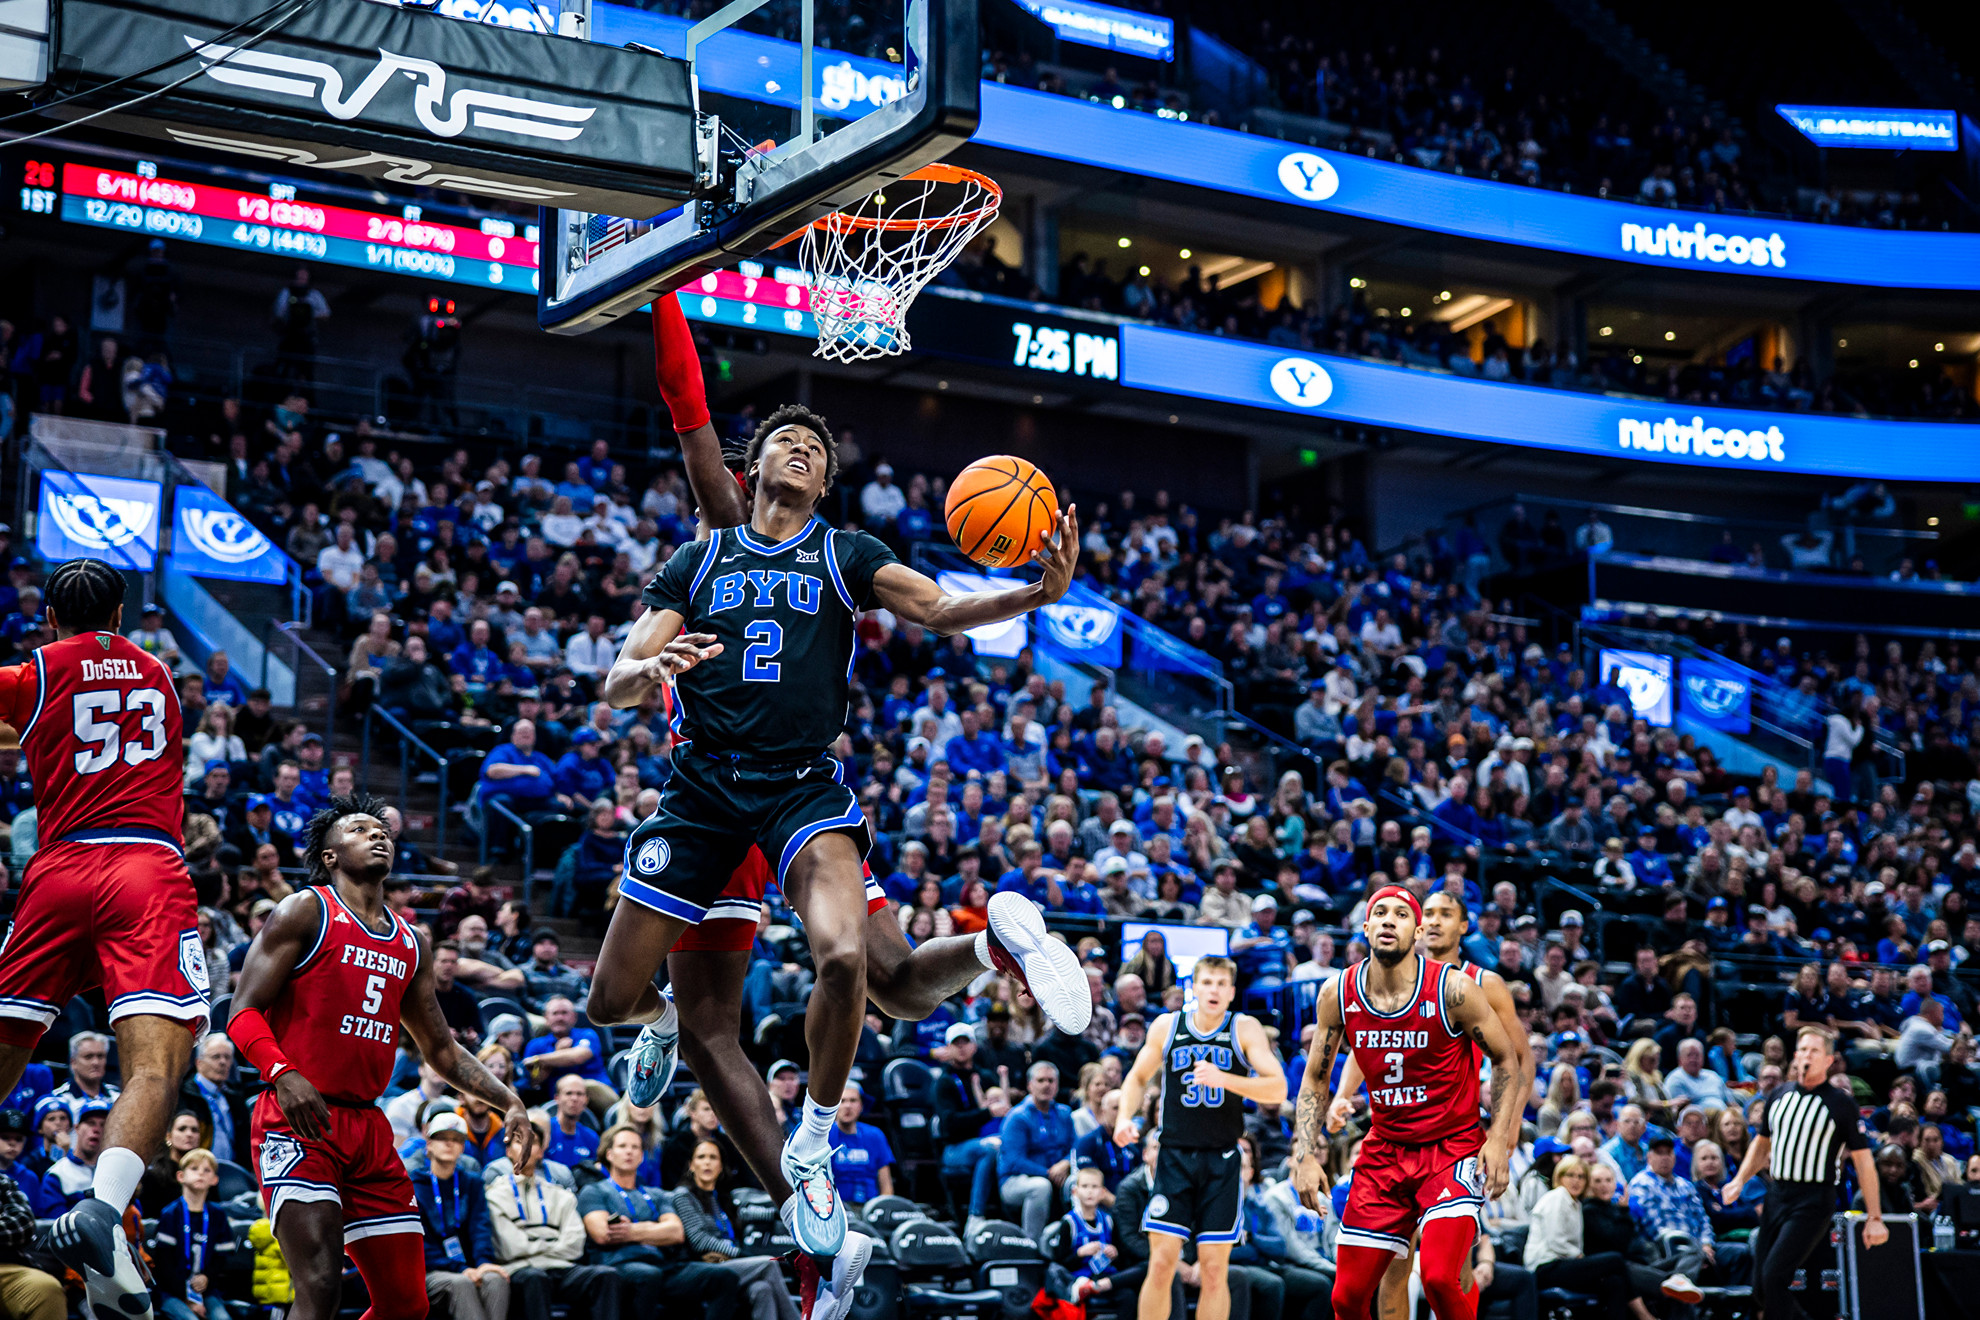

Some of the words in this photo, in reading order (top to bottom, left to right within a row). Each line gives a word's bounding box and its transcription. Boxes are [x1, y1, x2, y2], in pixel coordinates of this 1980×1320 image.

[24, 160, 55, 188] 26
[1294, 160, 1323, 192] Y
[20, 187, 57, 214] 1ST
[84, 198, 144, 229] 12/20
[145, 207, 203, 240] (60%)
[232, 222, 271, 248] 4/9
[272, 228, 328, 260] (44%)
[365, 242, 394, 268] 1/1
[394, 246, 456, 280] (100%)
[488, 262, 504, 285] 3
[742, 302, 758, 324] 2
[237, 196, 269, 221] 1/3
[270, 201, 326, 232] (33%)
[367, 216, 403, 243] 2/3
[487, 236, 505, 259] 0
[743, 277, 758, 299] 7
[1621, 222, 1786, 268] nutricost
[1012, 322, 1071, 373] 7:25
[1074, 332, 1118, 381] PM
[1287, 366, 1317, 398] Y
[1618, 416, 1785, 462] nutricost
[709, 569, 823, 615] BYU
[743, 619, 784, 682] 2
[81, 658, 143, 681] DuSELL
[73, 687, 168, 776] 53
[341, 944, 407, 980] FRESNO
[362, 974, 387, 1015] 5
[340, 1014, 393, 1044] STATE
[1355, 1030, 1429, 1049] FRESNO
[1171, 1044, 1233, 1073] BYU
[1384, 1052, 1404, 1084] 3
[1181, 1071, 1225, 1108] 30
[1371, 1085, 1428, 1106] STATE
